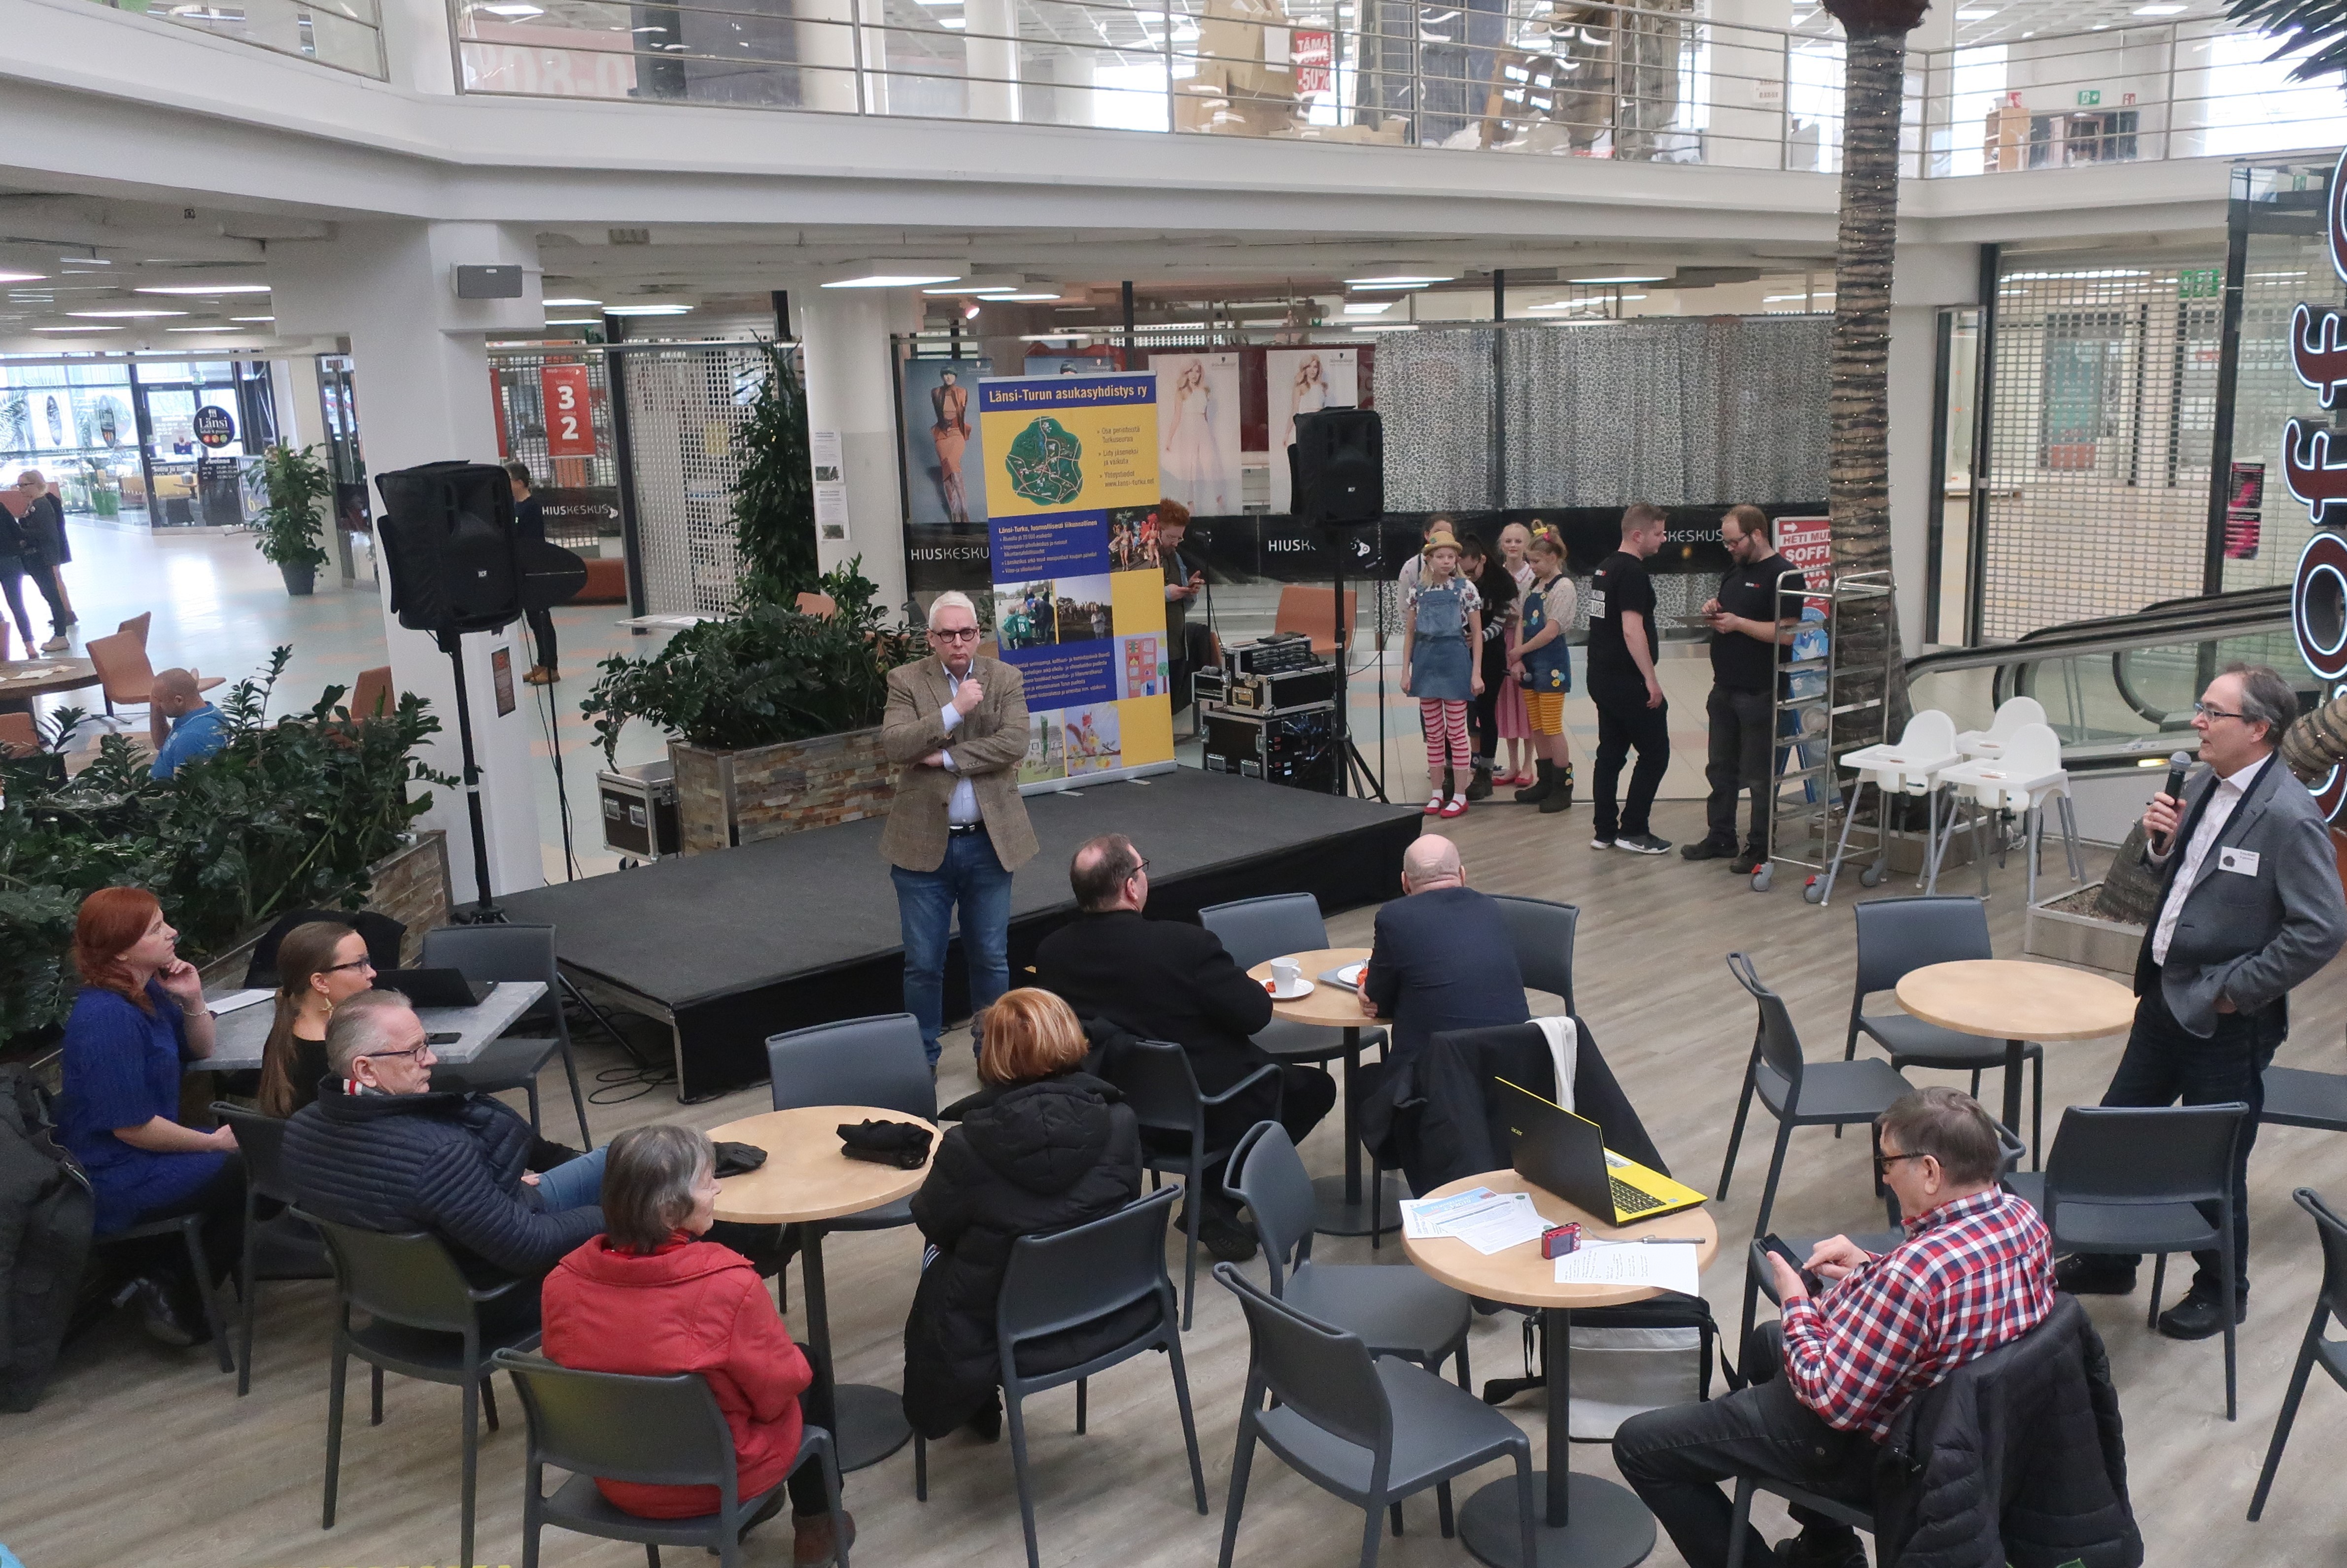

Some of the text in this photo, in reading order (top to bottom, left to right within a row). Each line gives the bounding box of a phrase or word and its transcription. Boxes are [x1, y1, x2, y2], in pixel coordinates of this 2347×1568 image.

[557, 385, 575, 409] 3
[989, 385, 1147, 403] Länsi-Turun asukasyhdistys ry
[199, 416, 228, 428] Länsi
[560, 416, 579, 440] 2
[542, 504, 608, 515] HIUSKESKUS
[1663, 529, 1724, 542] KESKUS
[1784, 534, 1807, 544] HETI
[911, 547, 990, 561] HIUSKESKU
[1511, 1126, 1523, 1136] acer
